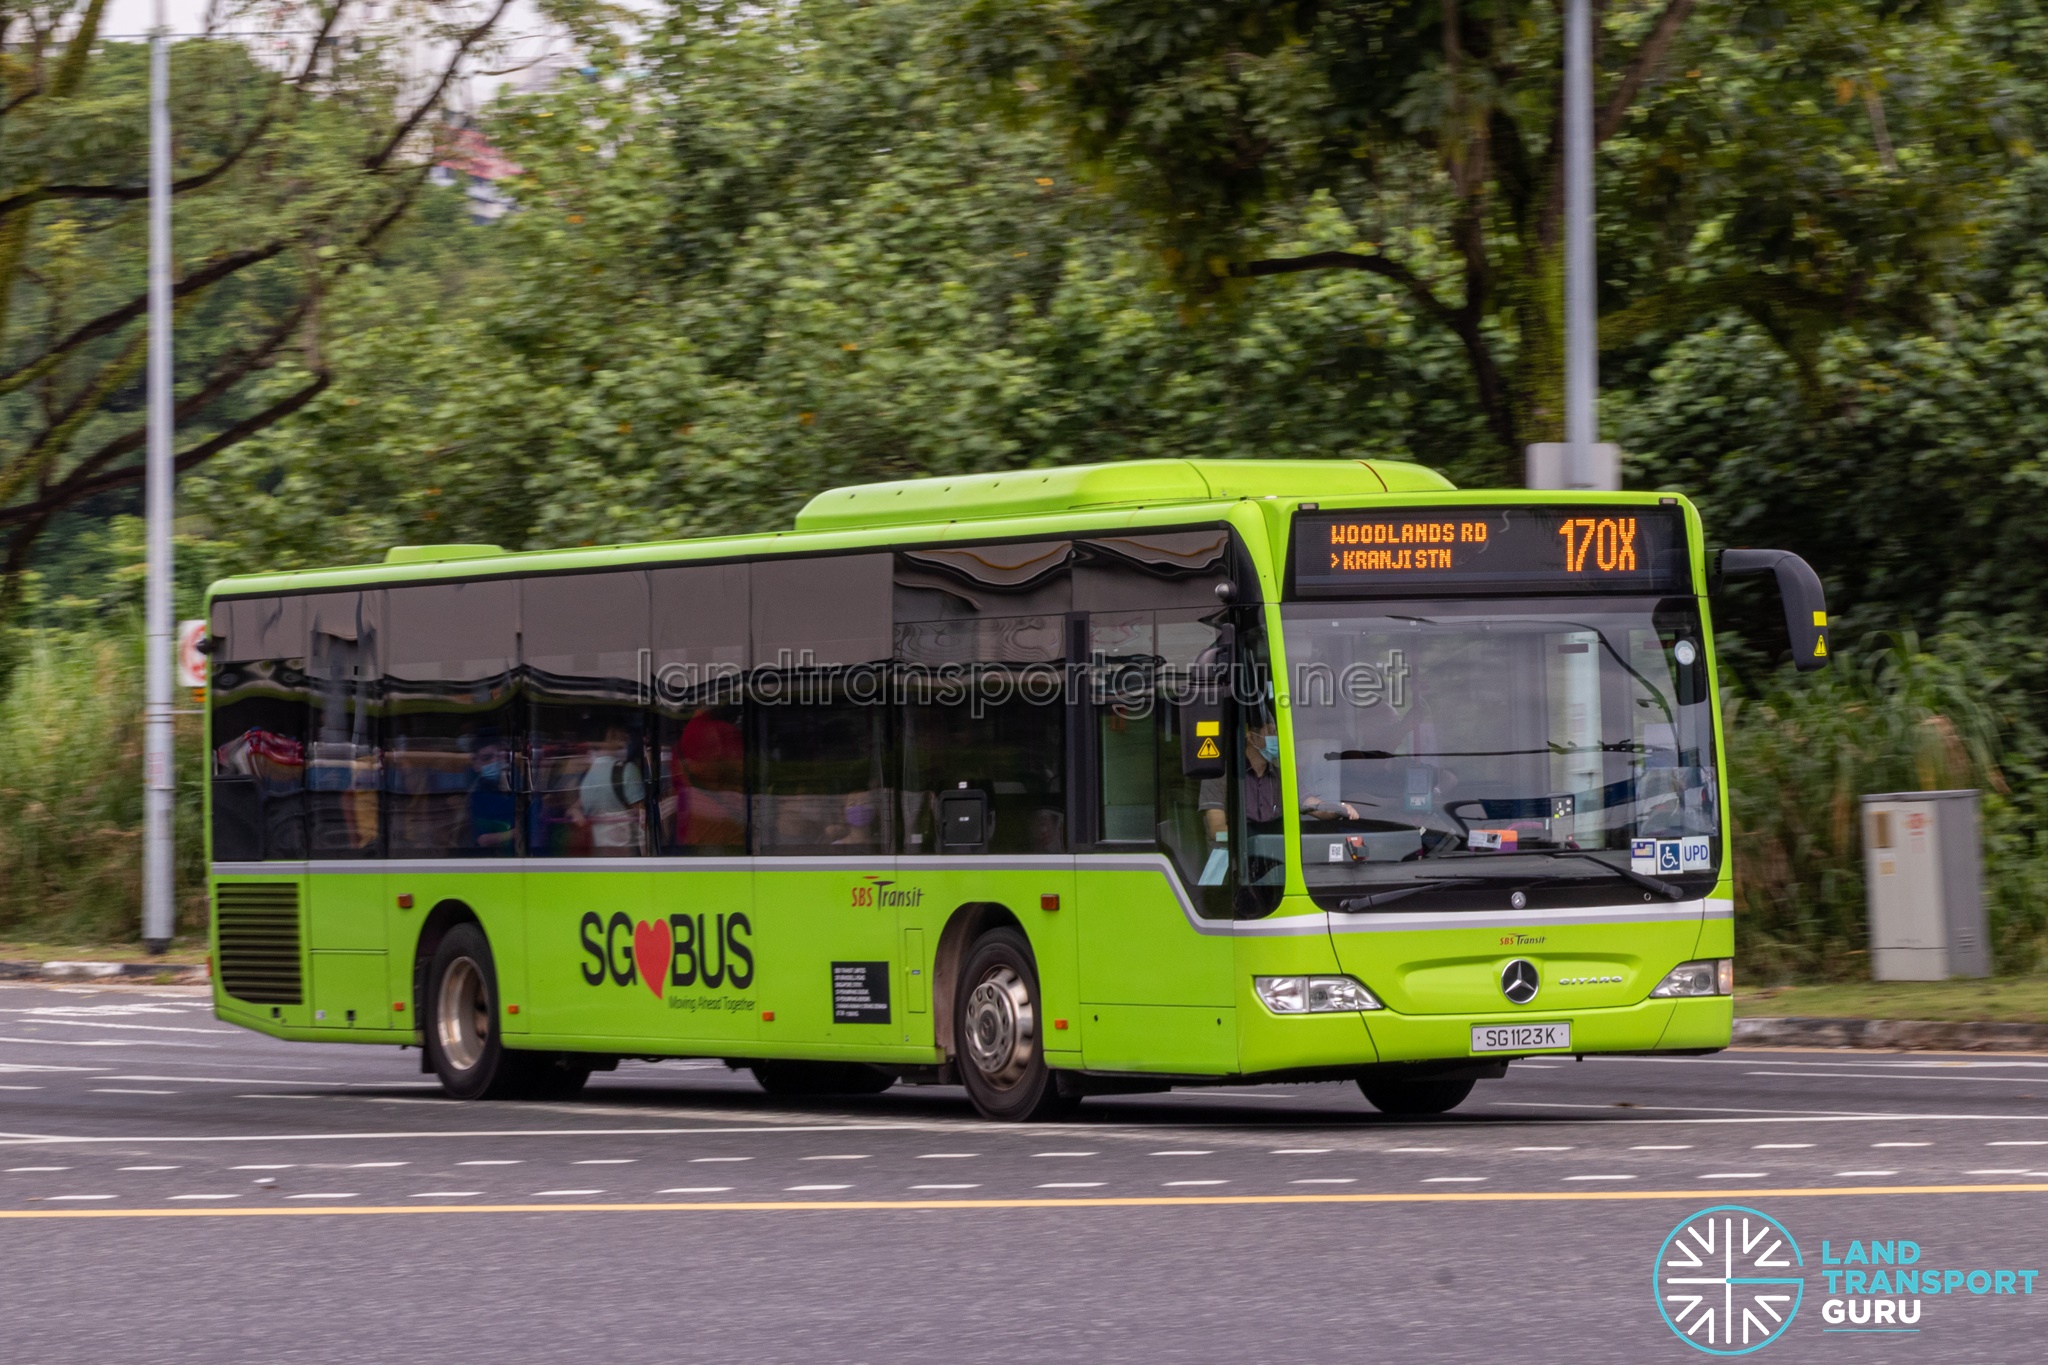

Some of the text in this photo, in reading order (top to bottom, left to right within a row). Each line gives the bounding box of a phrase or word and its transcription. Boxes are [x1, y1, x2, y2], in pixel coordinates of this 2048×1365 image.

[1331, 522, 1487, 544] WOODLANDS RD
[1559, 518, 1637, 572] 170X
[1343, 549, 1452, 570] KRANJI STN
[1684, 844, 1710, 862] UPD
[851, 880, 925, 911] SBS Transit
[580, 911, 754, 990] SG BUS
[1499, 934, 1546, 946] SBS Transit
[1559, 975, 1623, 986] CITARO
[668, 996, 756, 1013] Moving Ahead Together
[1486, 1027, 1556, 1048] SG1123K
